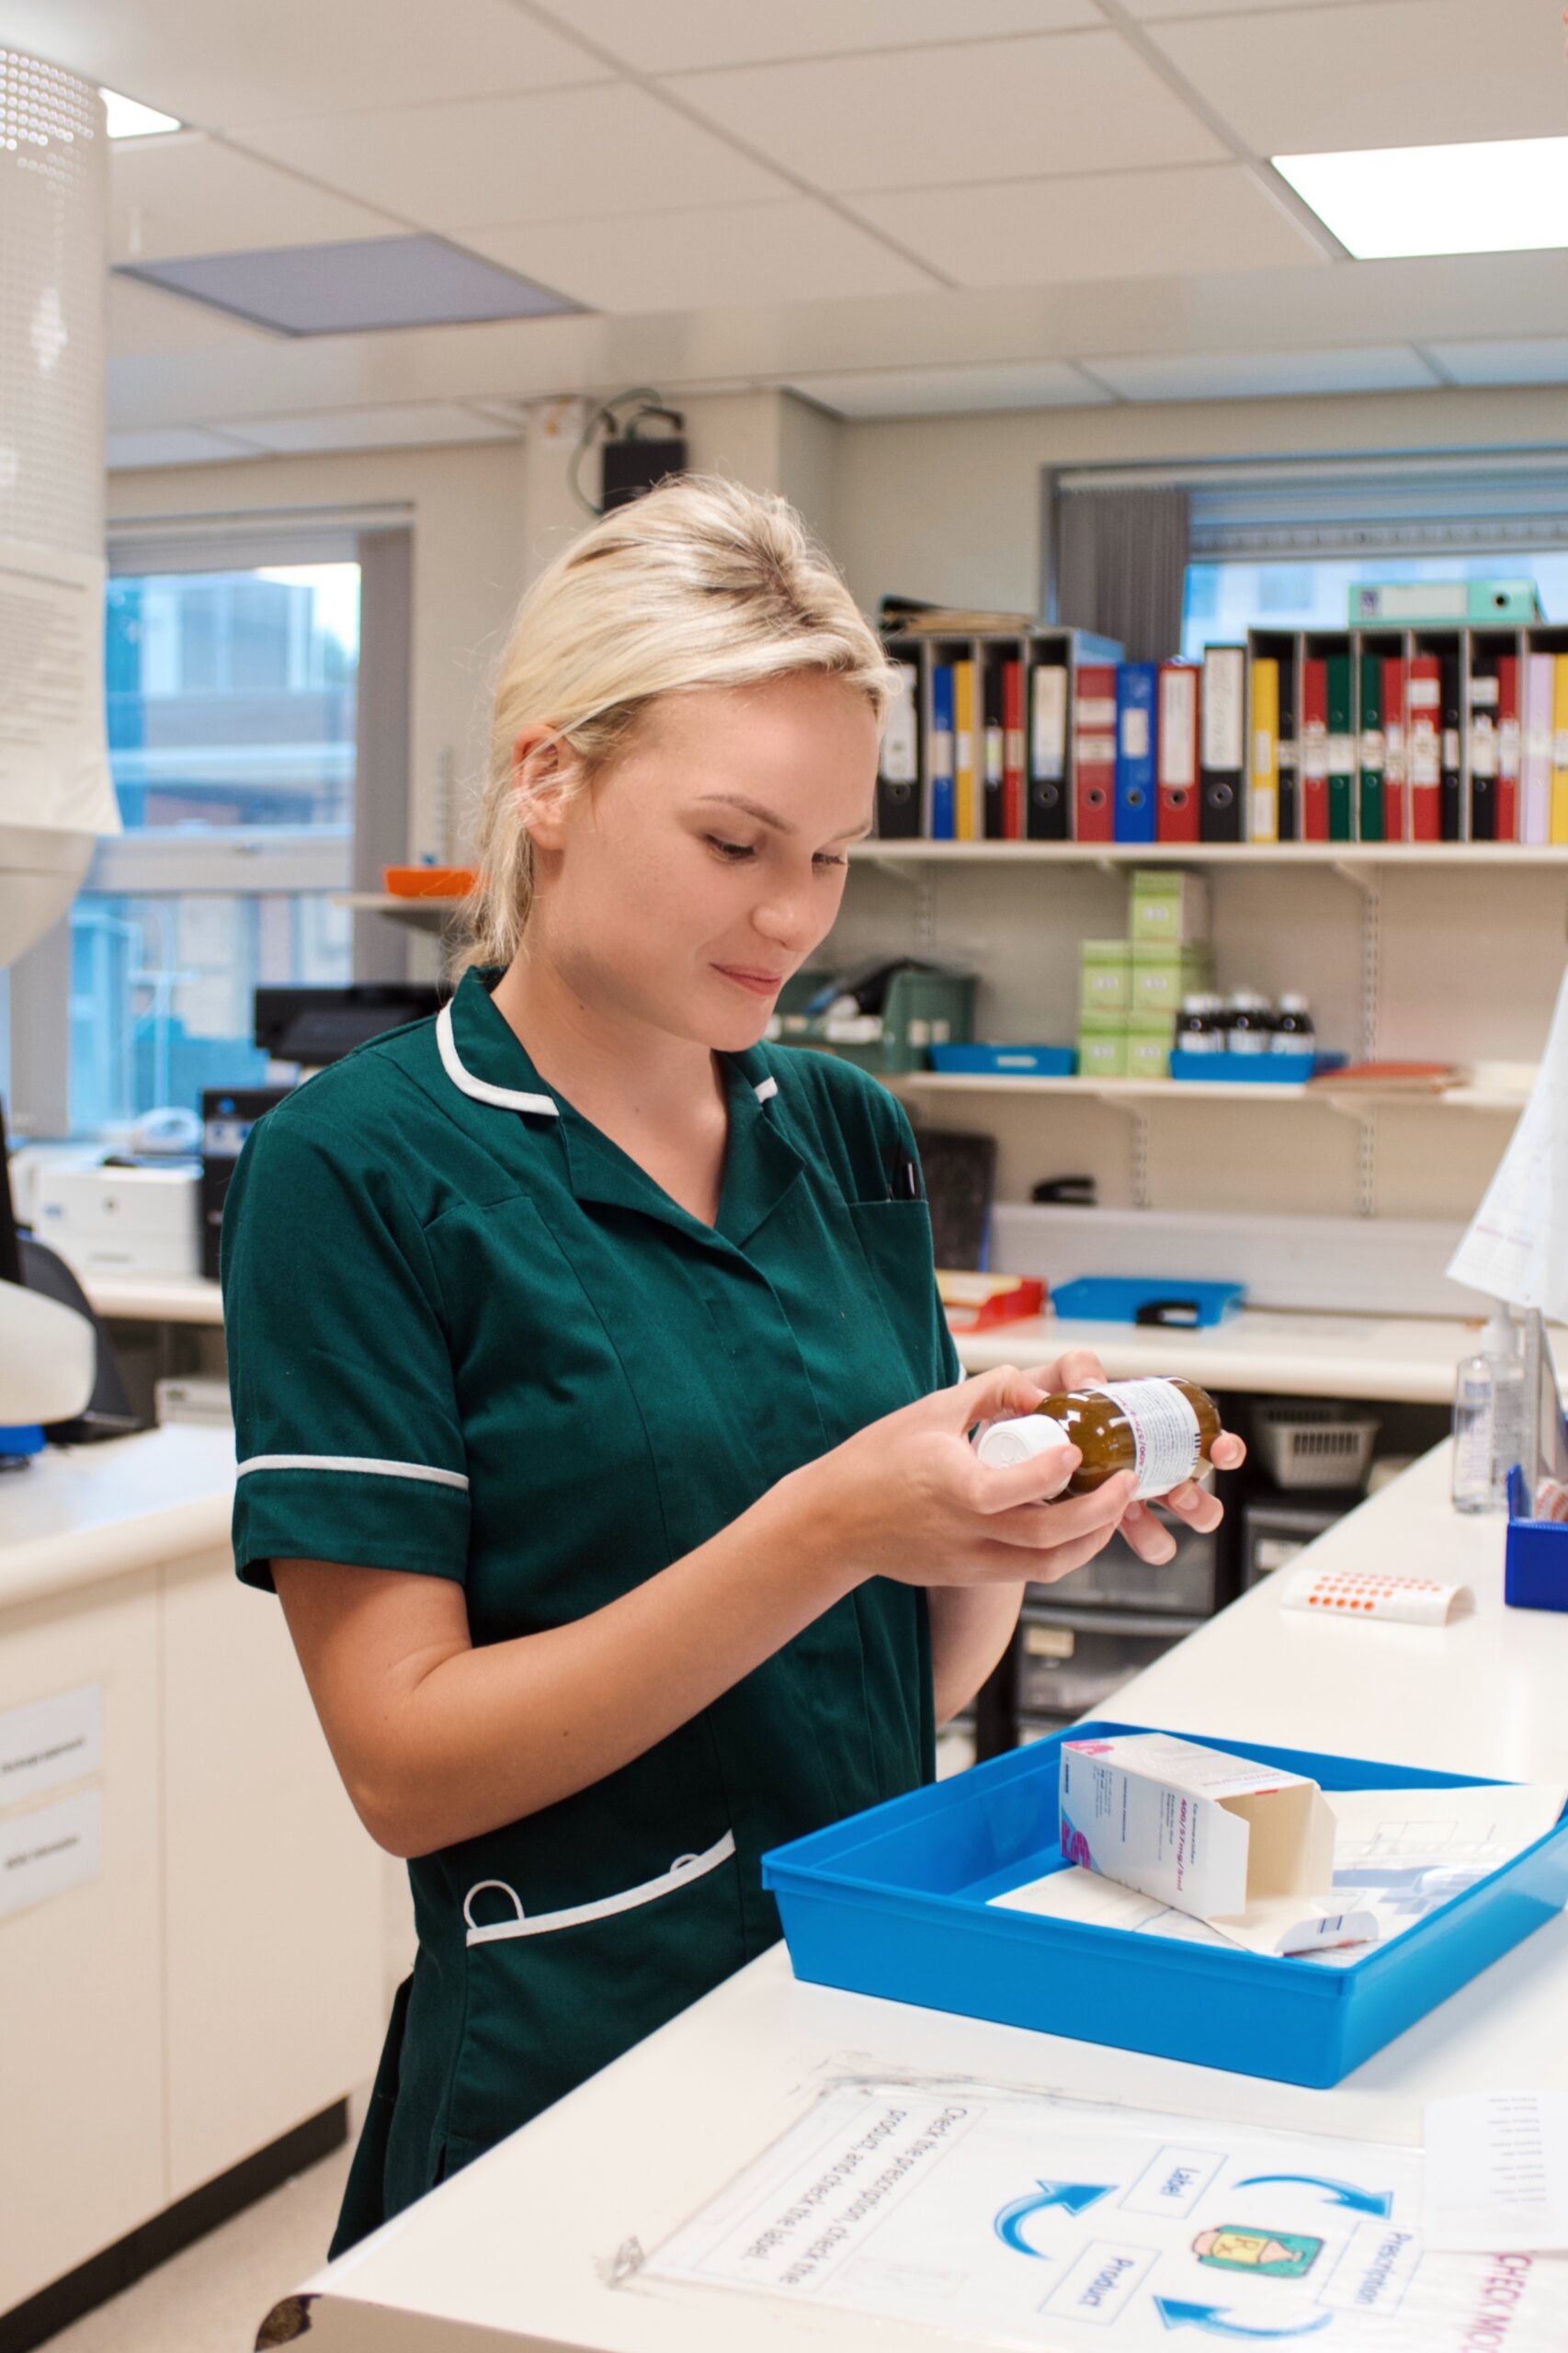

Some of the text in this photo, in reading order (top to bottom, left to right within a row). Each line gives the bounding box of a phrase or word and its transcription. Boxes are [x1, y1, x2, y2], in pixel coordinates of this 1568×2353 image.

[1176, 1798, 1187, 1892] 400/57mg/5ml
[740, 2108, 907, 2260] product, and check the label.
[779, 2106, 968, 2284] Check the prescription, check the
[1159, 2166, 1201, 2198] Label
[1077, 2256, 1135, 2307] Product
[1355, 2231, 1413, 2305] Prescription
[1475, 2254, 1533, 2310] CHECK
